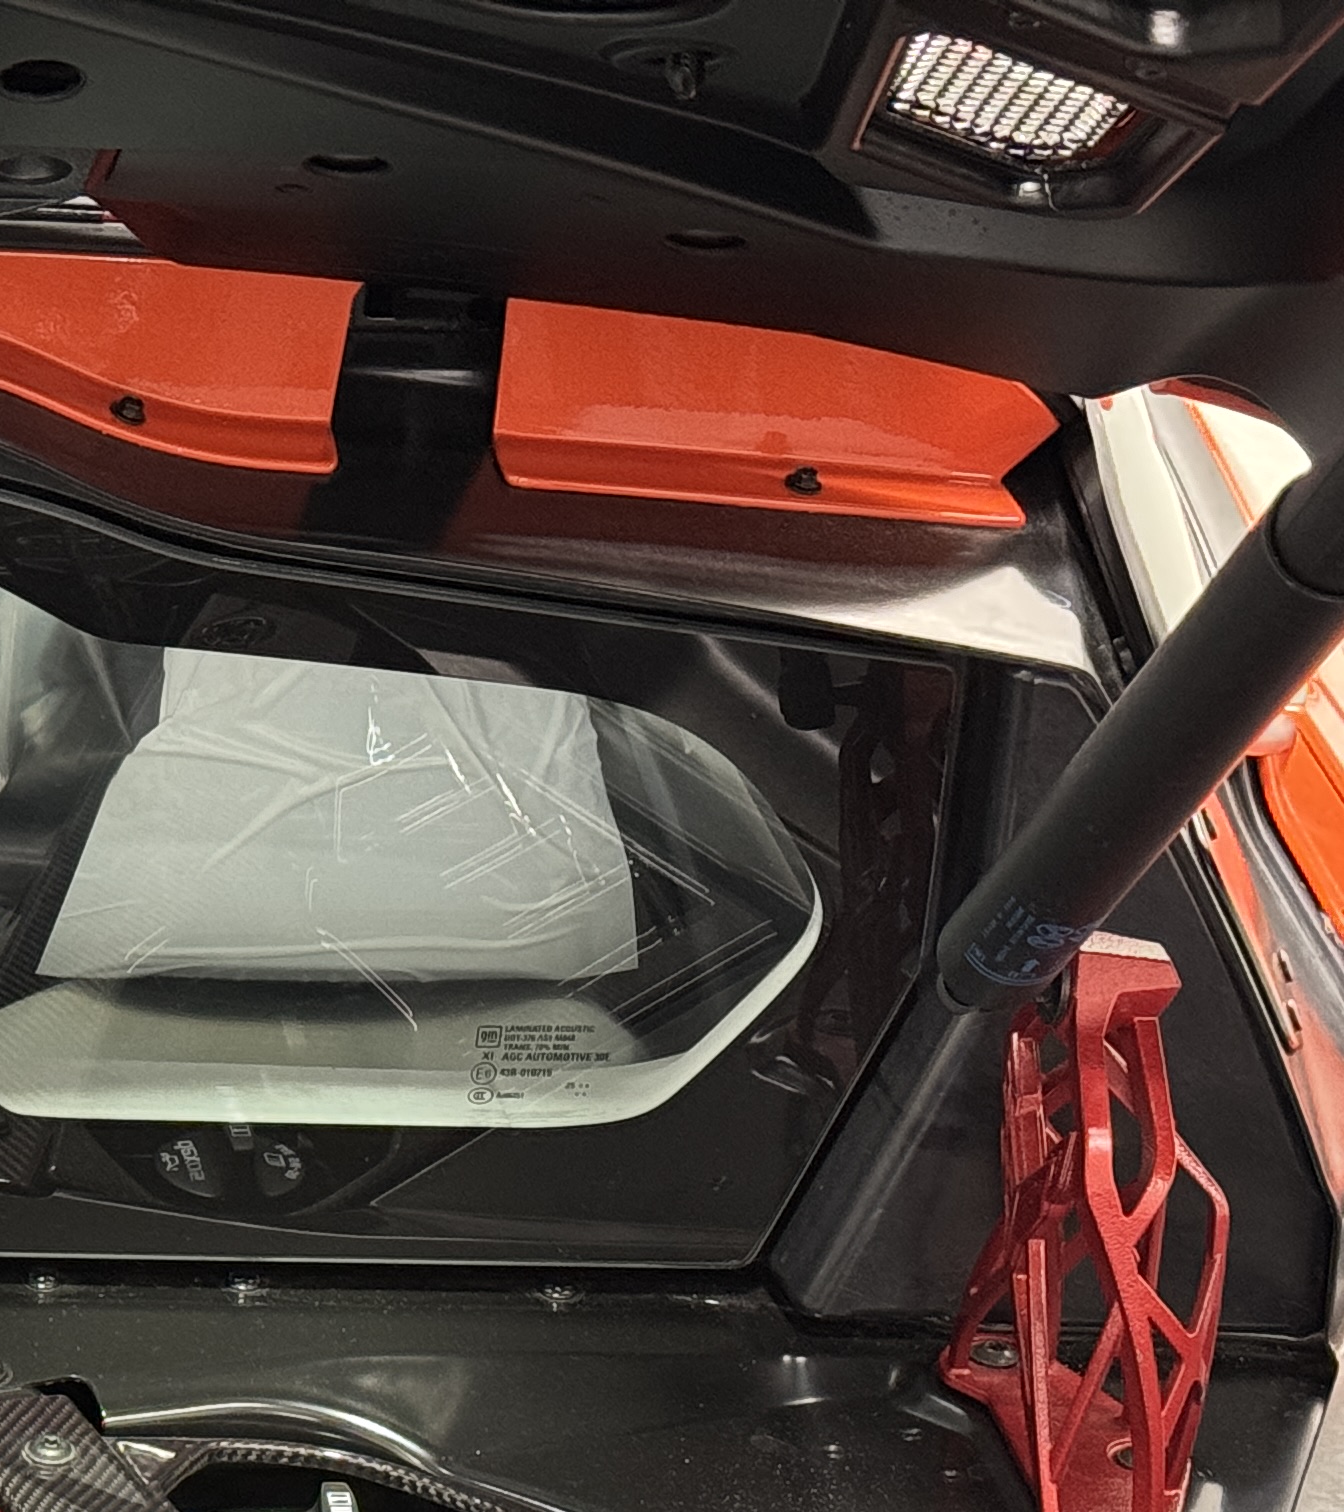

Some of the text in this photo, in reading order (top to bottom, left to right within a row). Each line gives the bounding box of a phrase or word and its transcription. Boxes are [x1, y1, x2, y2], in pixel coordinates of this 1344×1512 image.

[554, 1025, 596, 1033] ACOUSTIC
[480, 1030, 499, 1043] gm
[501, 1052, 524, 1062] AGC
[525, 1052, 593, 1062] AUTOMOTIVE
